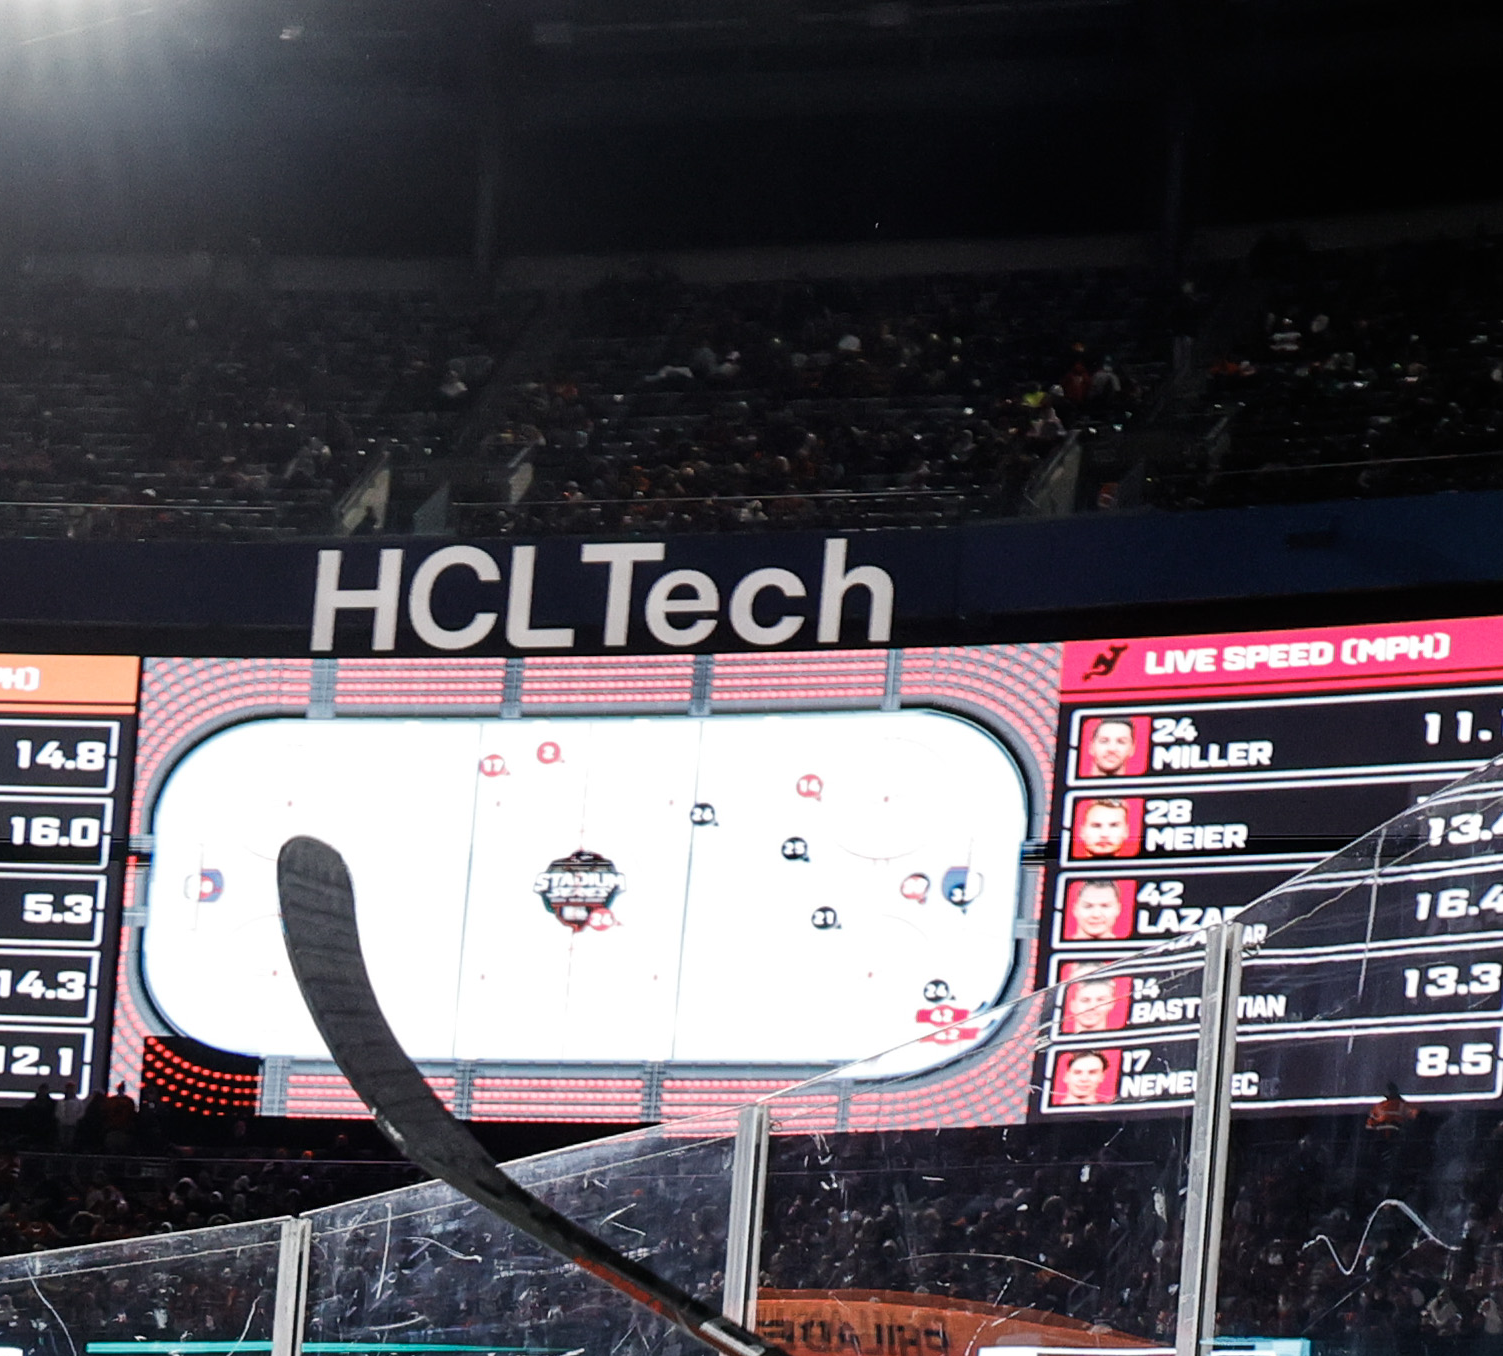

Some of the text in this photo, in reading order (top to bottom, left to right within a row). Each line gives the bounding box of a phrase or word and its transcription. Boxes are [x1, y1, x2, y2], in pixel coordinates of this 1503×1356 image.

[308, 538, 896, 652] HCLTech
[1144, 632, 1451, 675] LIVE SPEED (MPH)
[1151, 718, 1198, 743] 24
[15, 740, 108, 771] 14.8
[1151, 741, 1273, 772] MILLER
[1144, 799, 1192, 826] 28
[9, 816, 102, 847] 16.0
[1144, 824, 1249, 852] MEIER
[22, 893, 95, 925] 5.3
[1136, 881, 1184, 907] 42
[1132, 977, 1160, 1001] 14
[1403, 962, 1503, 1000] 13.3
[1121, 1051, 1151, 1073] 17
[1415, 1042, 1494, 1077] 8.5
